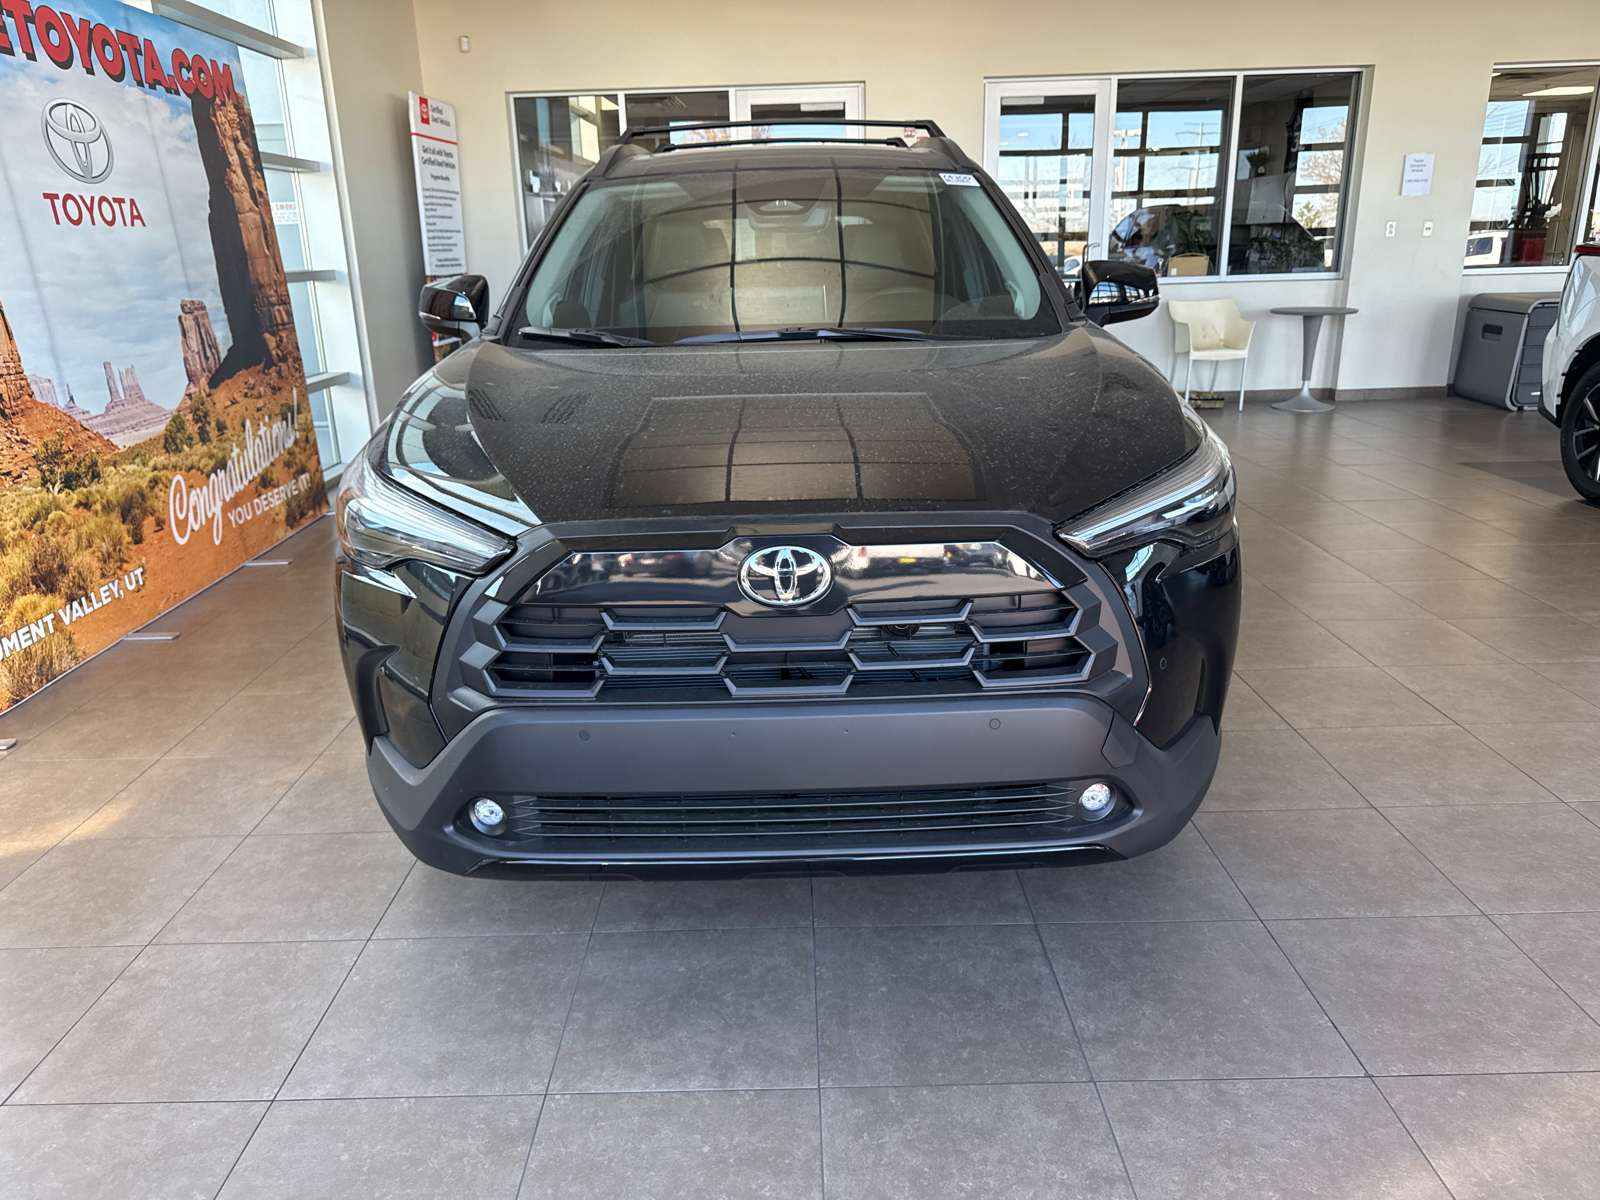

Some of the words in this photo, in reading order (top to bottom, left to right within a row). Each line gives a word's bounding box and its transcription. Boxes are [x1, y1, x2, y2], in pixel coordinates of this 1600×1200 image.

[42, 191, 147, 228] TOYOTA
[169, 387, 300, 546] Congratulations!
[227, 502, 252, 528] YOU
[253, 481, 299, 515] DESERVE
[299, 472, 312, 492] IT!
[57, 578, 125, 626] VALLEY,
[124, 567, 144, 592] UT
